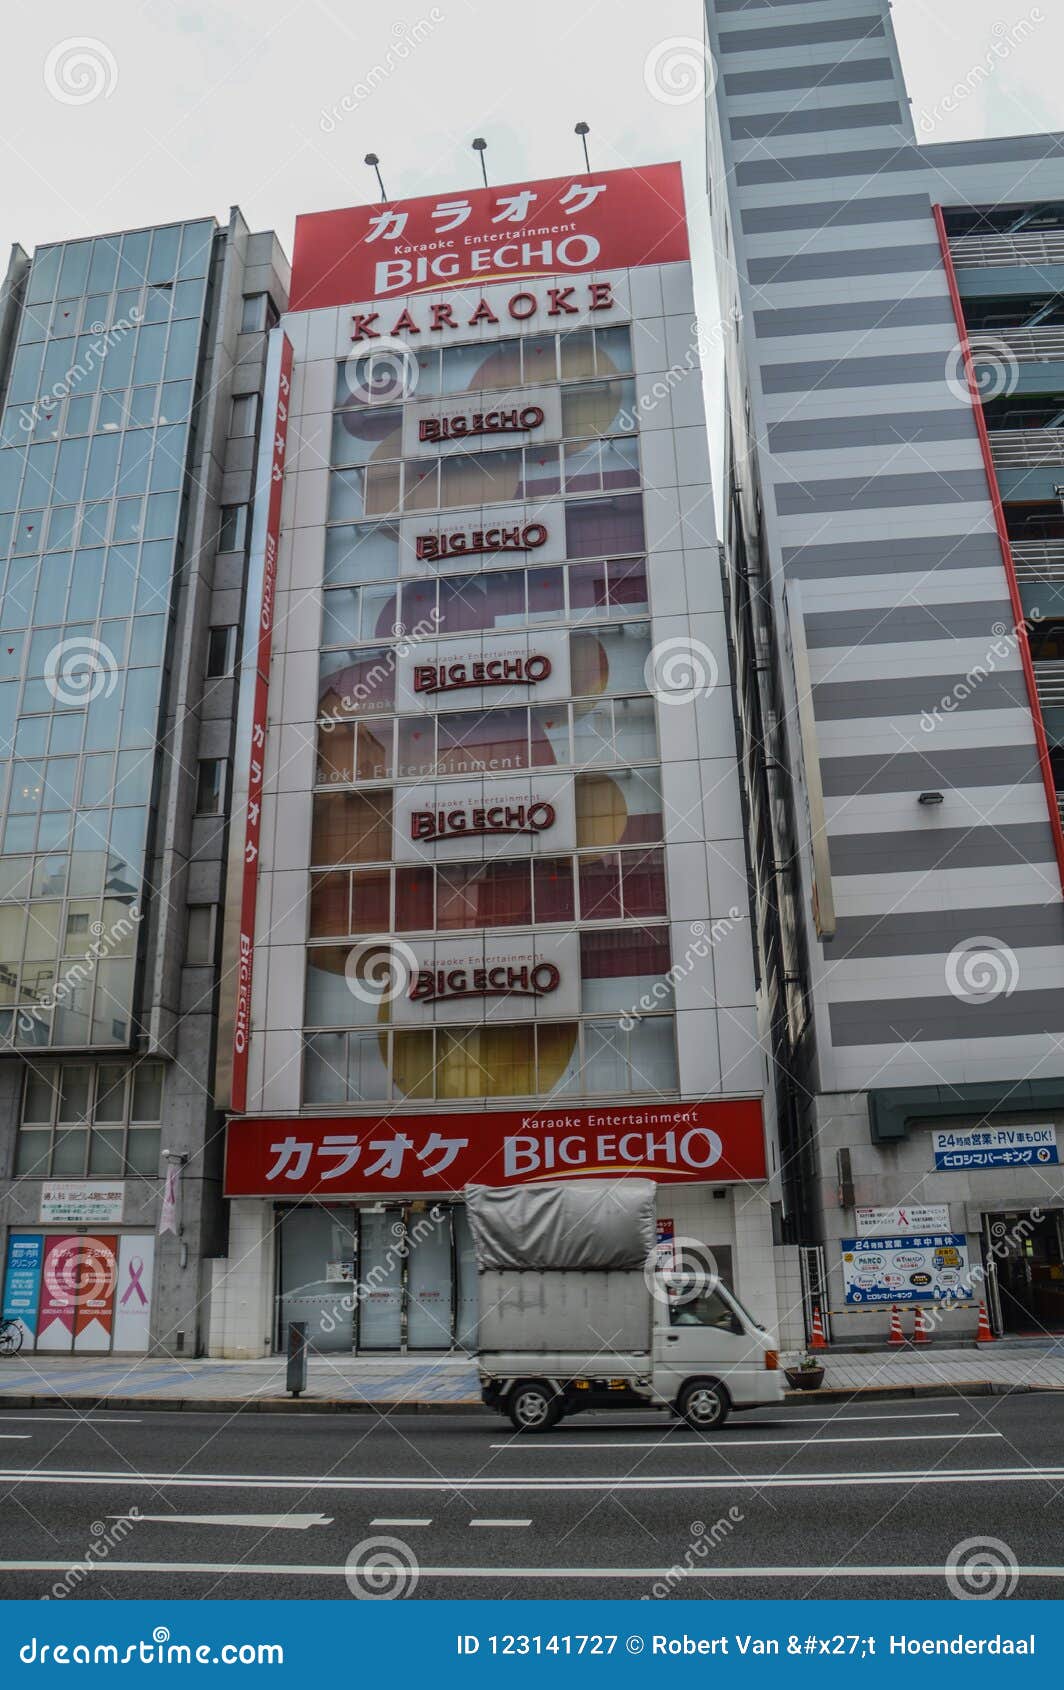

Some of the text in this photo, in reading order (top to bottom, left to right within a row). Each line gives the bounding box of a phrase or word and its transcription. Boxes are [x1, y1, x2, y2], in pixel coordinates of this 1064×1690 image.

[364, 184, 607, 243] カラオケ
[394, 222, 577, 255] Karaoke Entertainment
[374, 234, 600, 294] BIG ECHO
[350, 282, 615, 341] KARAOKE
[419, 407, 544, 441] BIG ECHO
[416, 524, 548, 560] BIG ECHO
[414, 655, 552, 693] BIG ECHO
[373, 754, 522, 778] Entertainment
[245, 723, 266, 863] カラオケ
[411, 802, 556, 840] BIG ECHO
[423, 953, 544, 966] Karaoke Entertainment
[235, 933, 250, 1053] BIG ECHO
[409, 963, 561, 1000] BIG ECHO
[522, 1111, 698, 1129] Karaoke Entertainment
[265, 1132, 469, 1181] カラオケ
[504, 1128, 723, 1177] BIG ECHO
[943, 1150, 1033, 1166] ヒロシマパーキング
